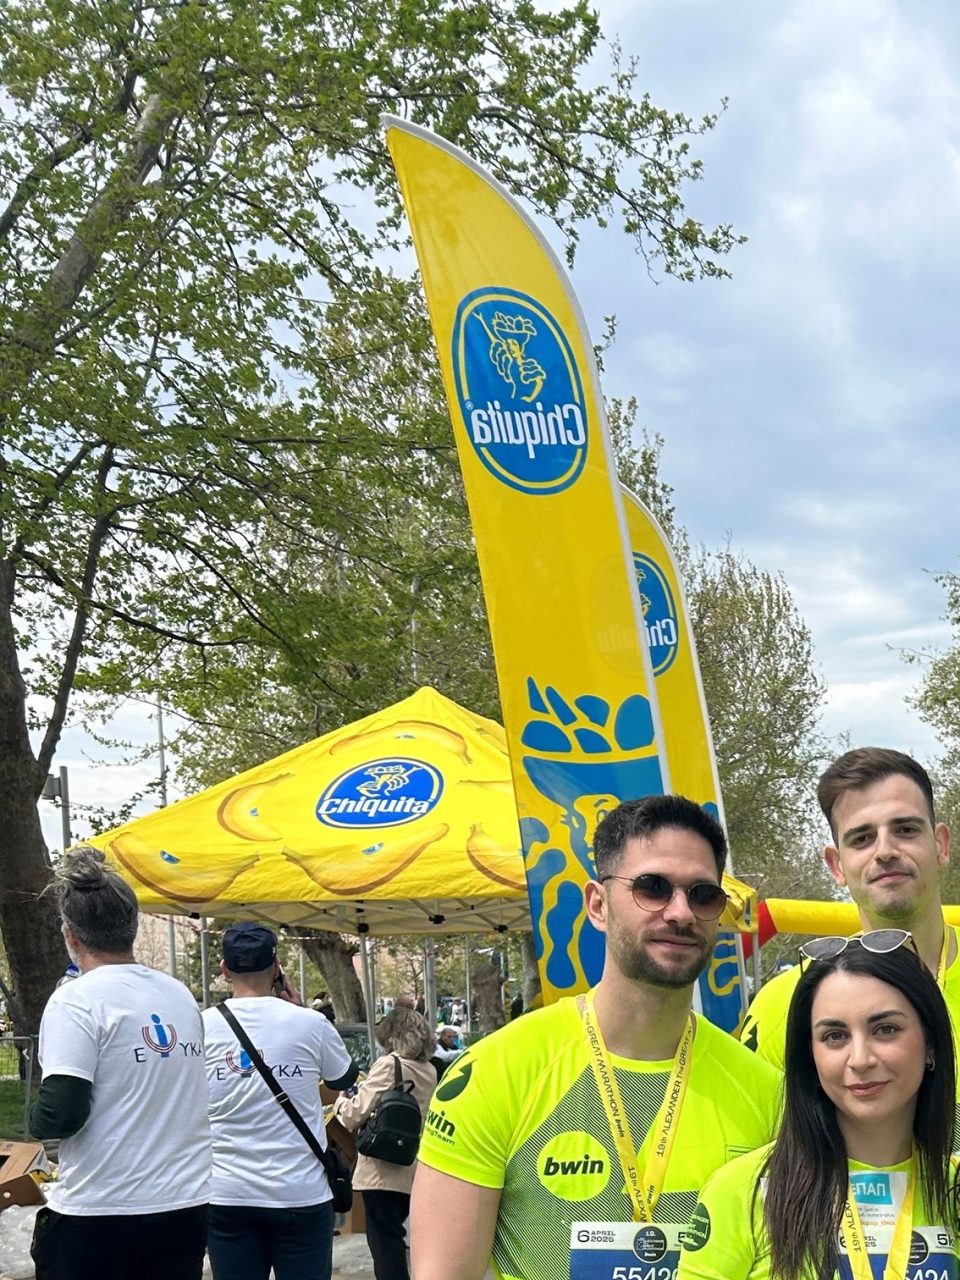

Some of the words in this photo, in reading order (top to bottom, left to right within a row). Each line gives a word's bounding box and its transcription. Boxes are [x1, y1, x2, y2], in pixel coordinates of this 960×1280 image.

[318, 796, 430, 817] Chiquita
[586, 1025, 603, 1058] GREAT
[596, 1059, 620, 1117] MARATHON
[662, 1080, 683, 1136] ALEXANDER
[543, 1154, 604, 1176] bwin
[852, 1183, 886, 1197] ΕΠΑΠ
[577, 1230, 590, 1242] 6
[937, 1234, 955, 1247] 5k
